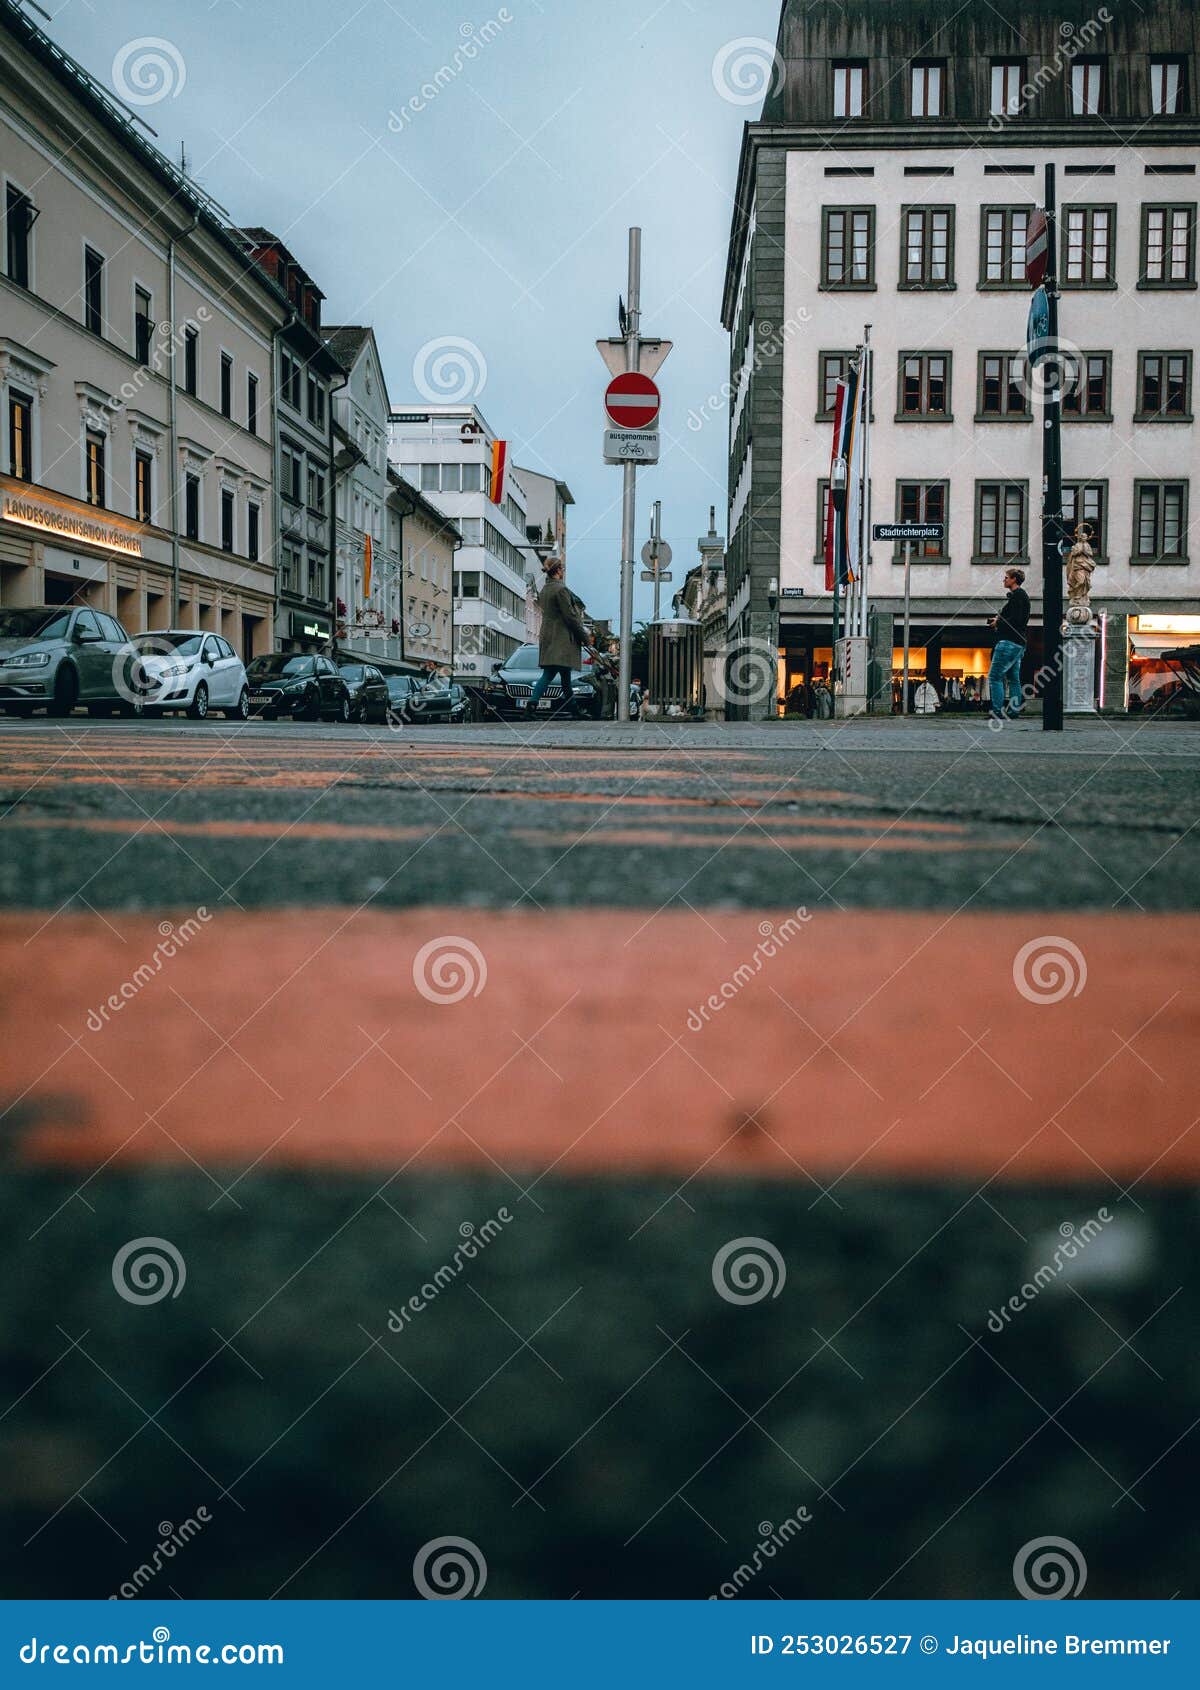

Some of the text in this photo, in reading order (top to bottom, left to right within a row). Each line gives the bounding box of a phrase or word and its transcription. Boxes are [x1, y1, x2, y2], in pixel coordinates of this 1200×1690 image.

[609, 432, 657, 442] ausgenommen
[6, 497, 107, 542] LANDESORGANISATION
[879, 527, 939, 538] Stadtrichterplatz
